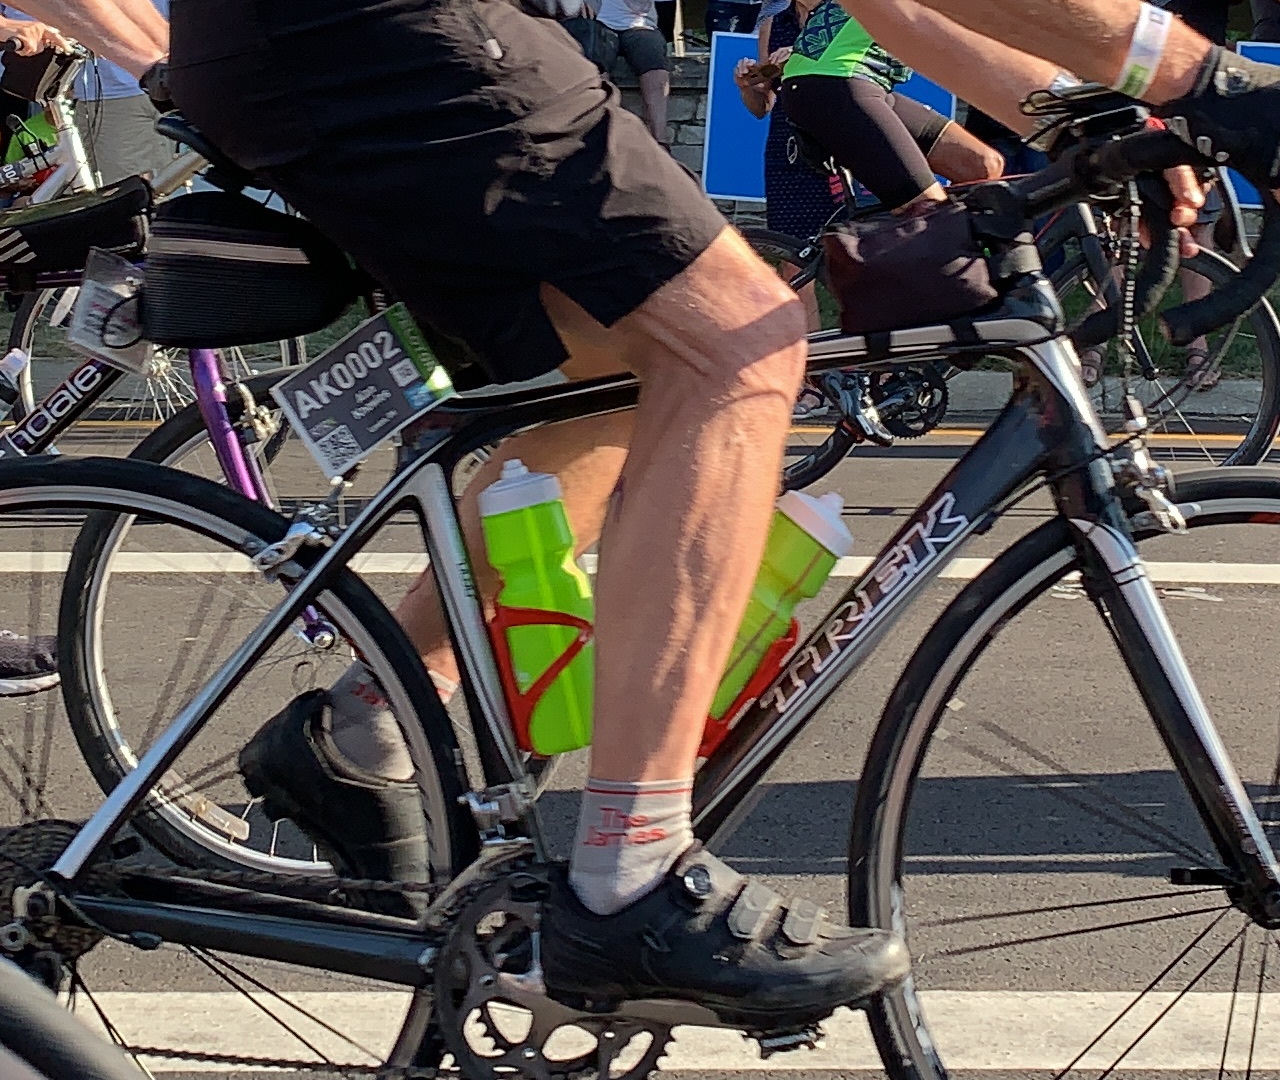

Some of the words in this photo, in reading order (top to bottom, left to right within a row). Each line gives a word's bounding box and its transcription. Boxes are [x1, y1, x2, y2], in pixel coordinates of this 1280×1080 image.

[293, 330, 403, 419] AK0002
[759, 491, 969, 714] TREK
[600, 806, 649, 829] The
